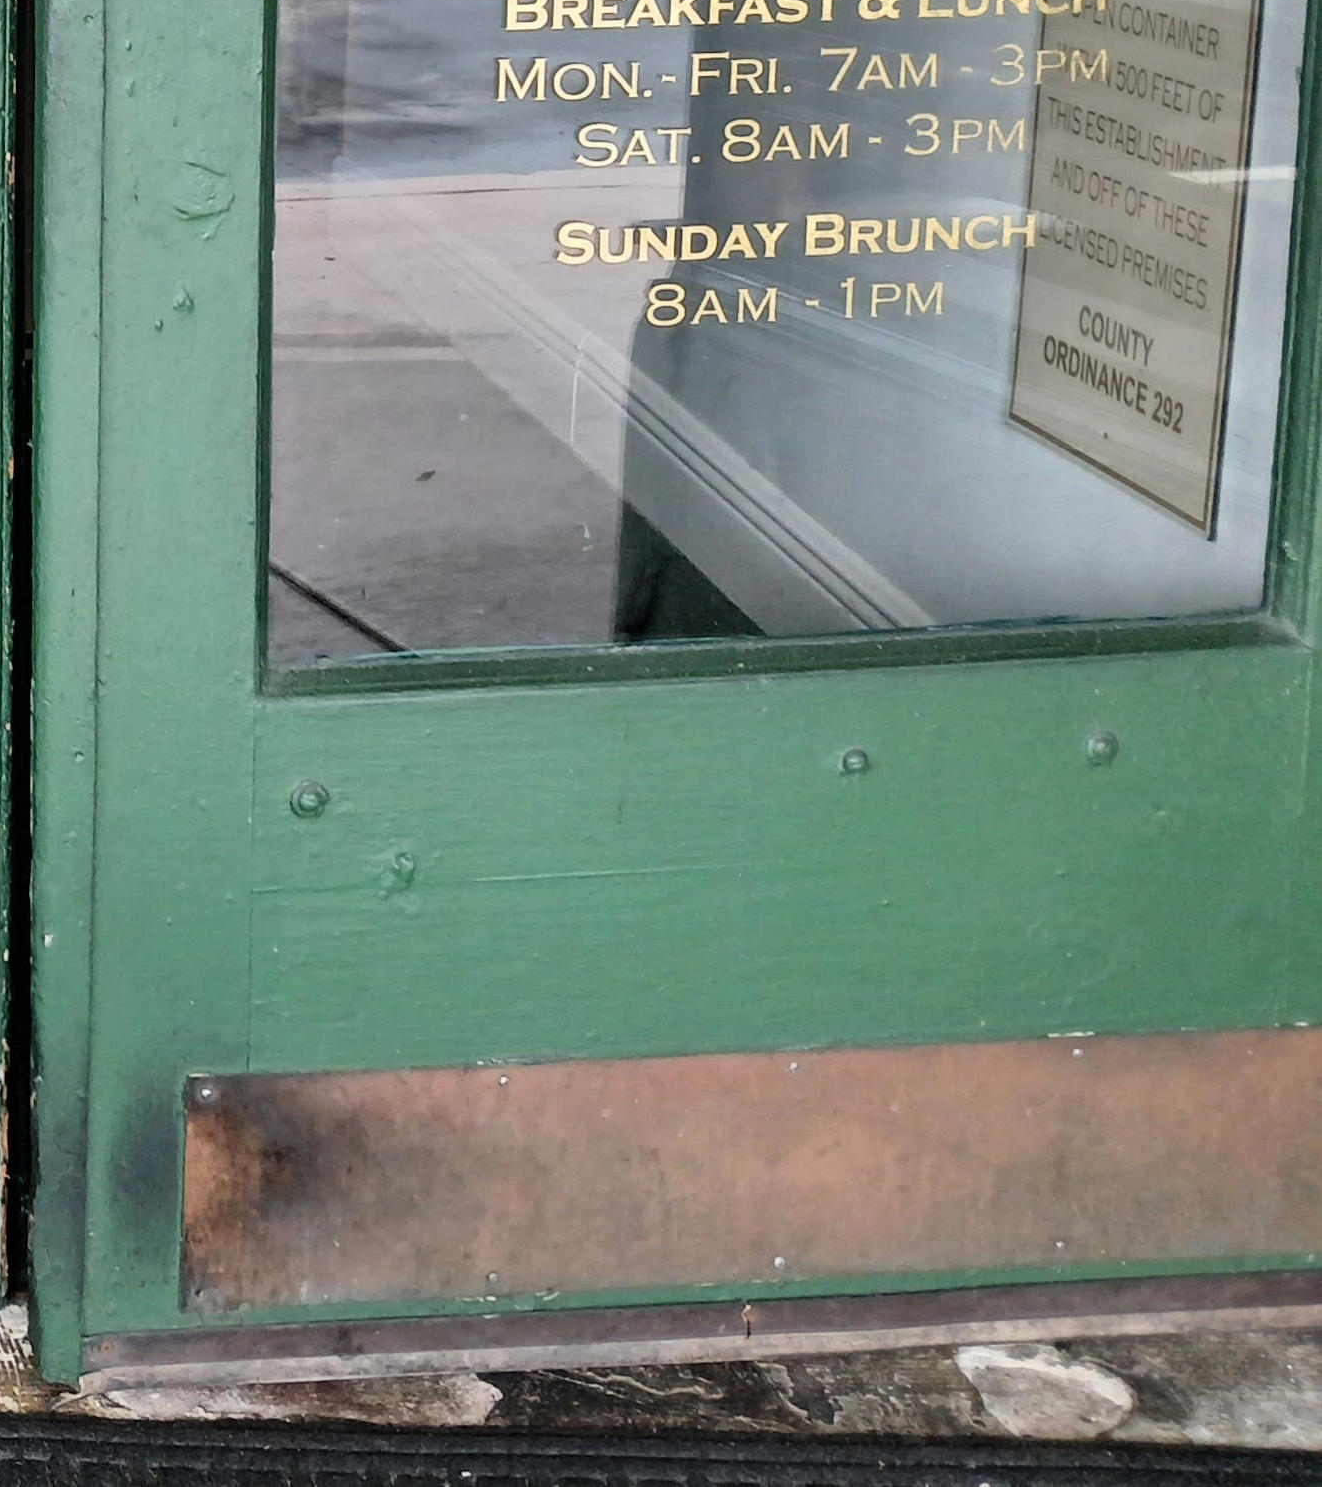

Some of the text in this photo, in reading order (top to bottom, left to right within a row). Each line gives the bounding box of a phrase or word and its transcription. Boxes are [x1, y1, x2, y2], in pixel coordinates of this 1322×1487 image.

[1118, 2, 1221, 61] CONTAINER
[819, 46, 939, 90] 7AM
[989, 43, 1109, 86] 3PM
[1116, 61, 1147, 100] 500
[1151, 71, 1196, 115] FEET
[1198, 90, 1226, 124] OF
[576, 123, 701, 168] SAT.
[721, 117, 850, 163] 8AM
[904, 113, 1026, 157] 3PM
[1047, 96, 1082, 136] THIS
[1051, 159, 1210, 248] AND OFF OF THESE
[556, 214, 1038, 265] SUNDAY BRUNCH
[1038, 211, 1119, 270] LICENSED
[645, 282, 778, 327] 8AM
[839, 278, 945, 320] 1PM
[1078, 304, 1155, 367] COUNTY
[1043, 335, 1185, 435] ORDINANCE 292
